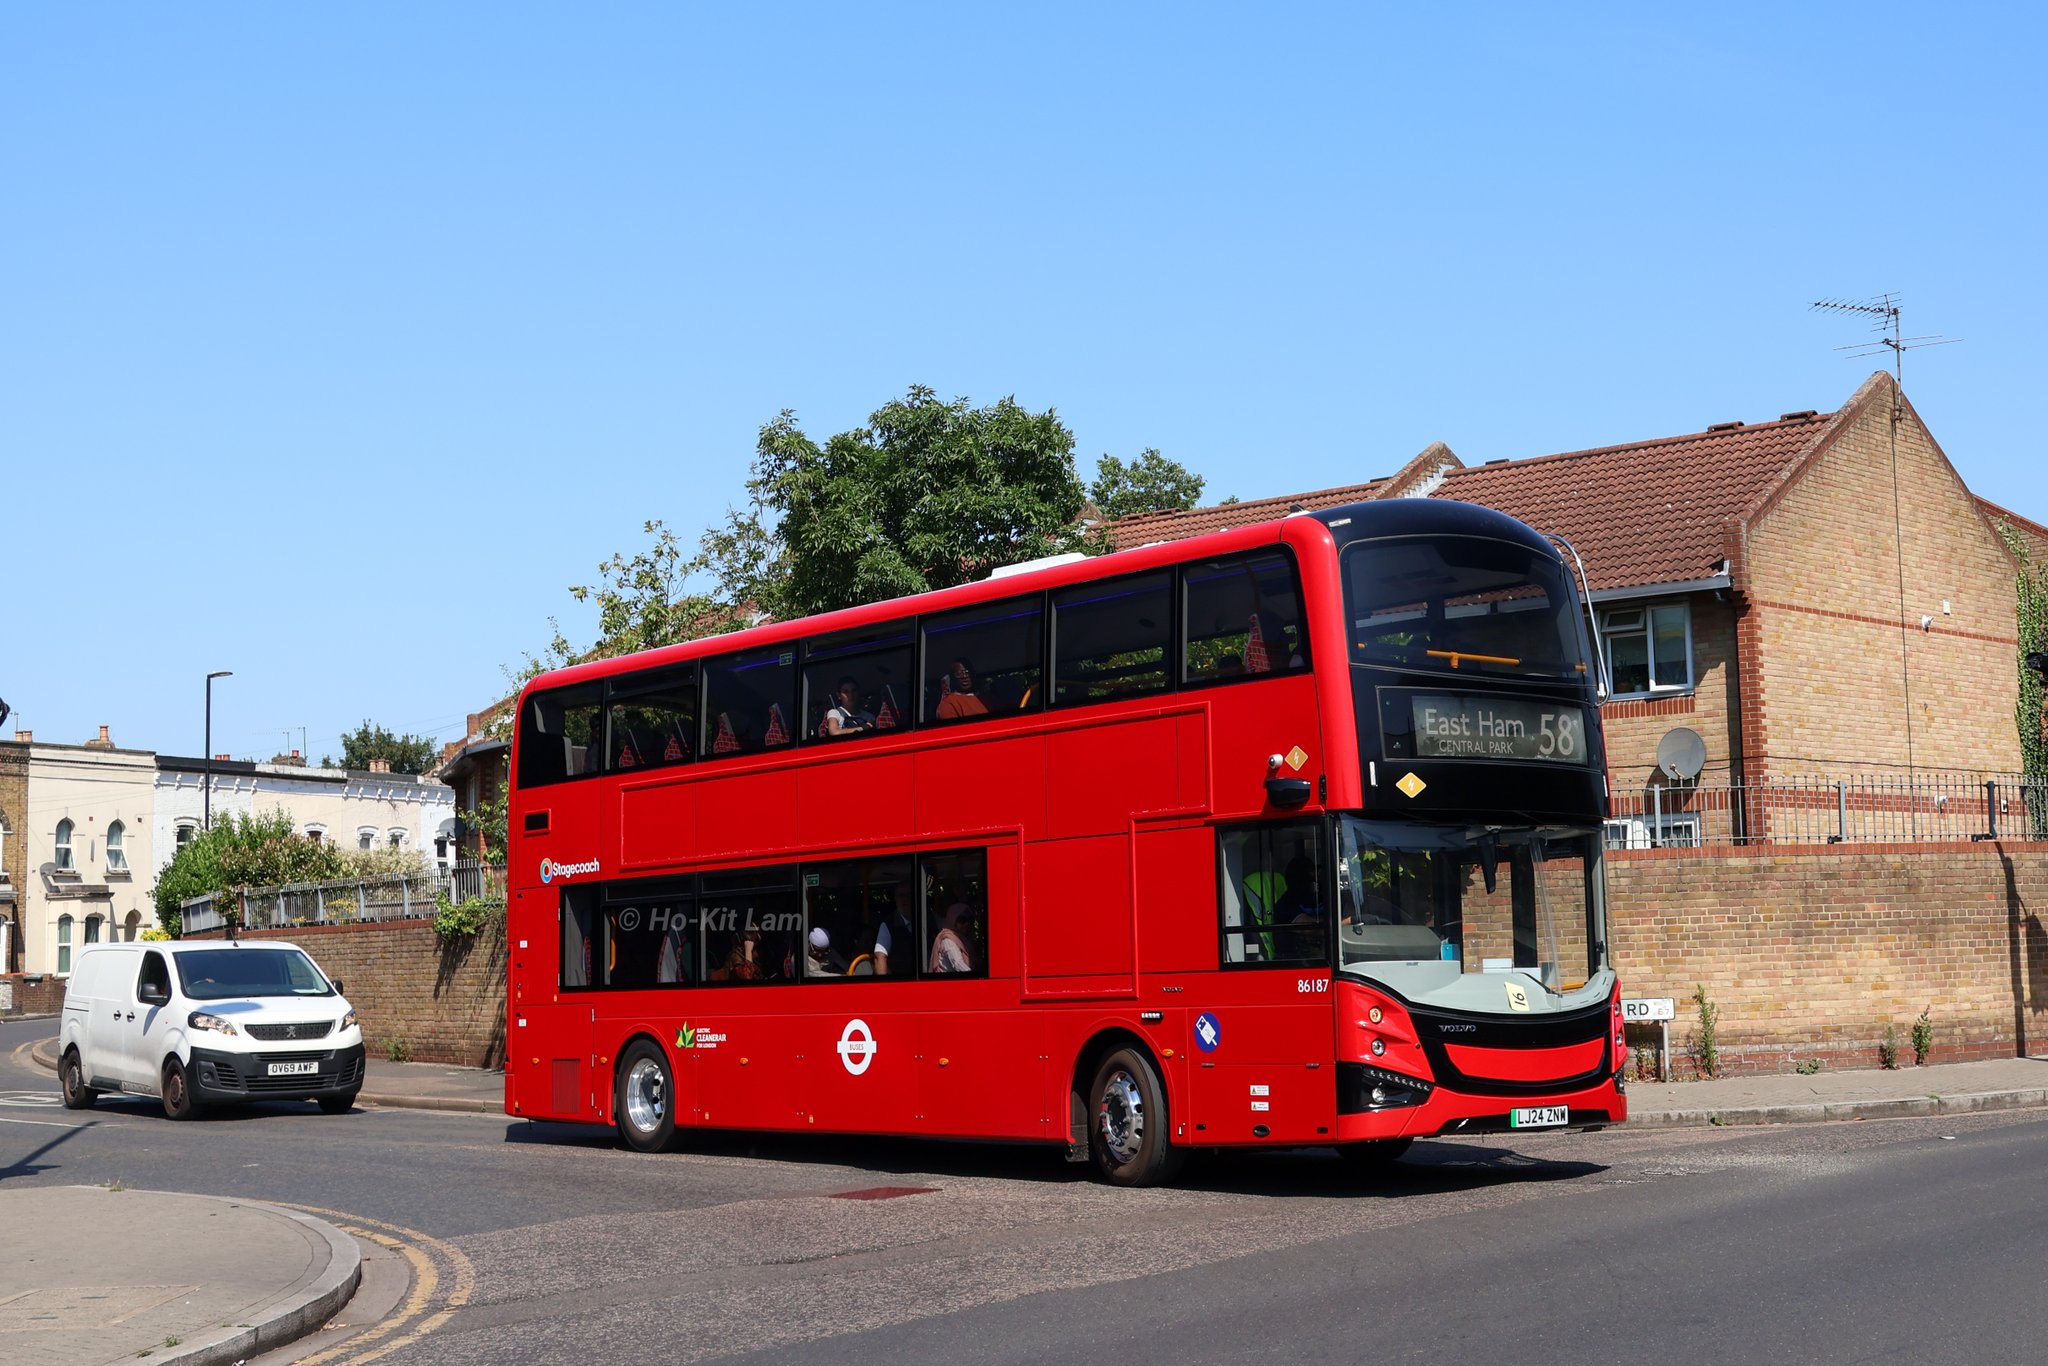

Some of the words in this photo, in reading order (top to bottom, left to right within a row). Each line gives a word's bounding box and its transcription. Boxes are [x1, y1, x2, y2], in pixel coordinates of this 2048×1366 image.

[1425, 708, 1471, 736] East
[1478, 710, 1525, 738] Ham
[1539, 713, 1574, 756] 58
[1438, 739, 1486, 753] CENTRAL
[1489, 740, 1514, 754] PARK
[552, 857, 600, 878] Stagecoach
[1297, 978, 1329, 993] 86187
[1626, 1003, 1649, 1016] RD
[1438, 1024, 1477, 1033] VOLVO
[849, 1043, 864, 1051] BUSES
[271, 1064, 295, 1074] OV69
[297, 1063, 314, 1073] AWF
[1517, 1109, 1544, 1124] LJ24
[1546, 1107, 1566, 1122] ZNW
